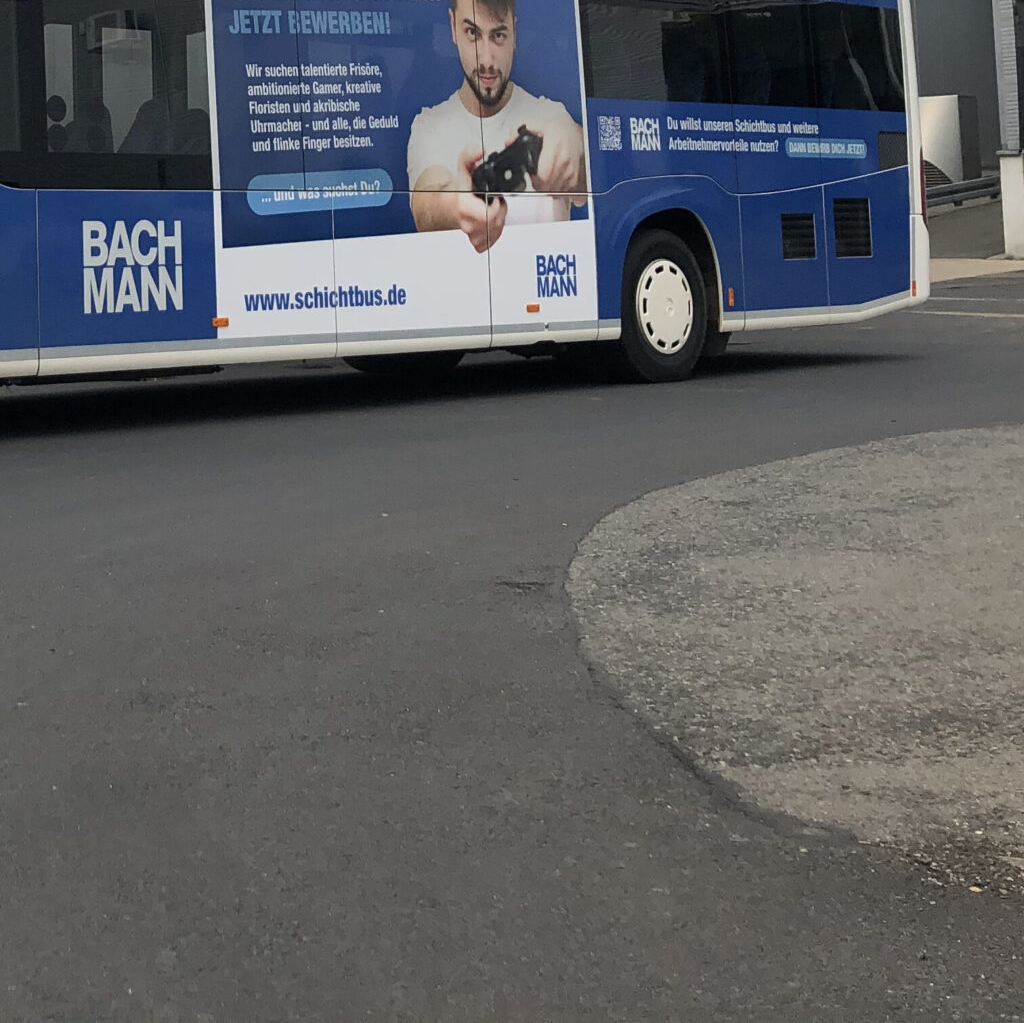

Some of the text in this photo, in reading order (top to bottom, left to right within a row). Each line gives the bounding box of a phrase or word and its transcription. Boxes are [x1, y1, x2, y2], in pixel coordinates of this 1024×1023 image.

[229, 9, 391, 34] JETZT BEWERBEN!
[245, 64, 263, 78] Wir
[265, 63, 299, 77] suchen
[301, 63, 348, 77] talentierte
[248, 81, 382, 97] ambitionierte Gamer, kreative
[249, 98, 360, 114] Floristen und akribische
[250, 120, 302, 134] Uhrmacher
[312, 117, 330, 131] und
[332, 116, 352, 131] alle,
[352, 116, 367, 129] die
[368, 115, 399, 128] Geduld
[630, 117, 659, 134] BACH
[667, 116, 819, 134] Du willst unseren Schichtbus und weitere
[252, 135, 374, 152] und flinke Finger besitzen.
[632, 134, 661, 151] MANN
[668, 137, 749, 152] Arbeitnehmervorteile
[750, 140, 779, 152] nutzen?
[273, 186, 295, 201] und
[297, 186, 320, 200] was
[322, 184, 358, 198] suchst
[360, 180, 381, 196] Du?
[82, 220, 183, 267] BACH
[536, 254, 577, 277] BACH
[83, 265, 184, 315] MANN
[537, 276, 578, 298] MANN
[244, 284, 407, 312] www.schichtbus.de
